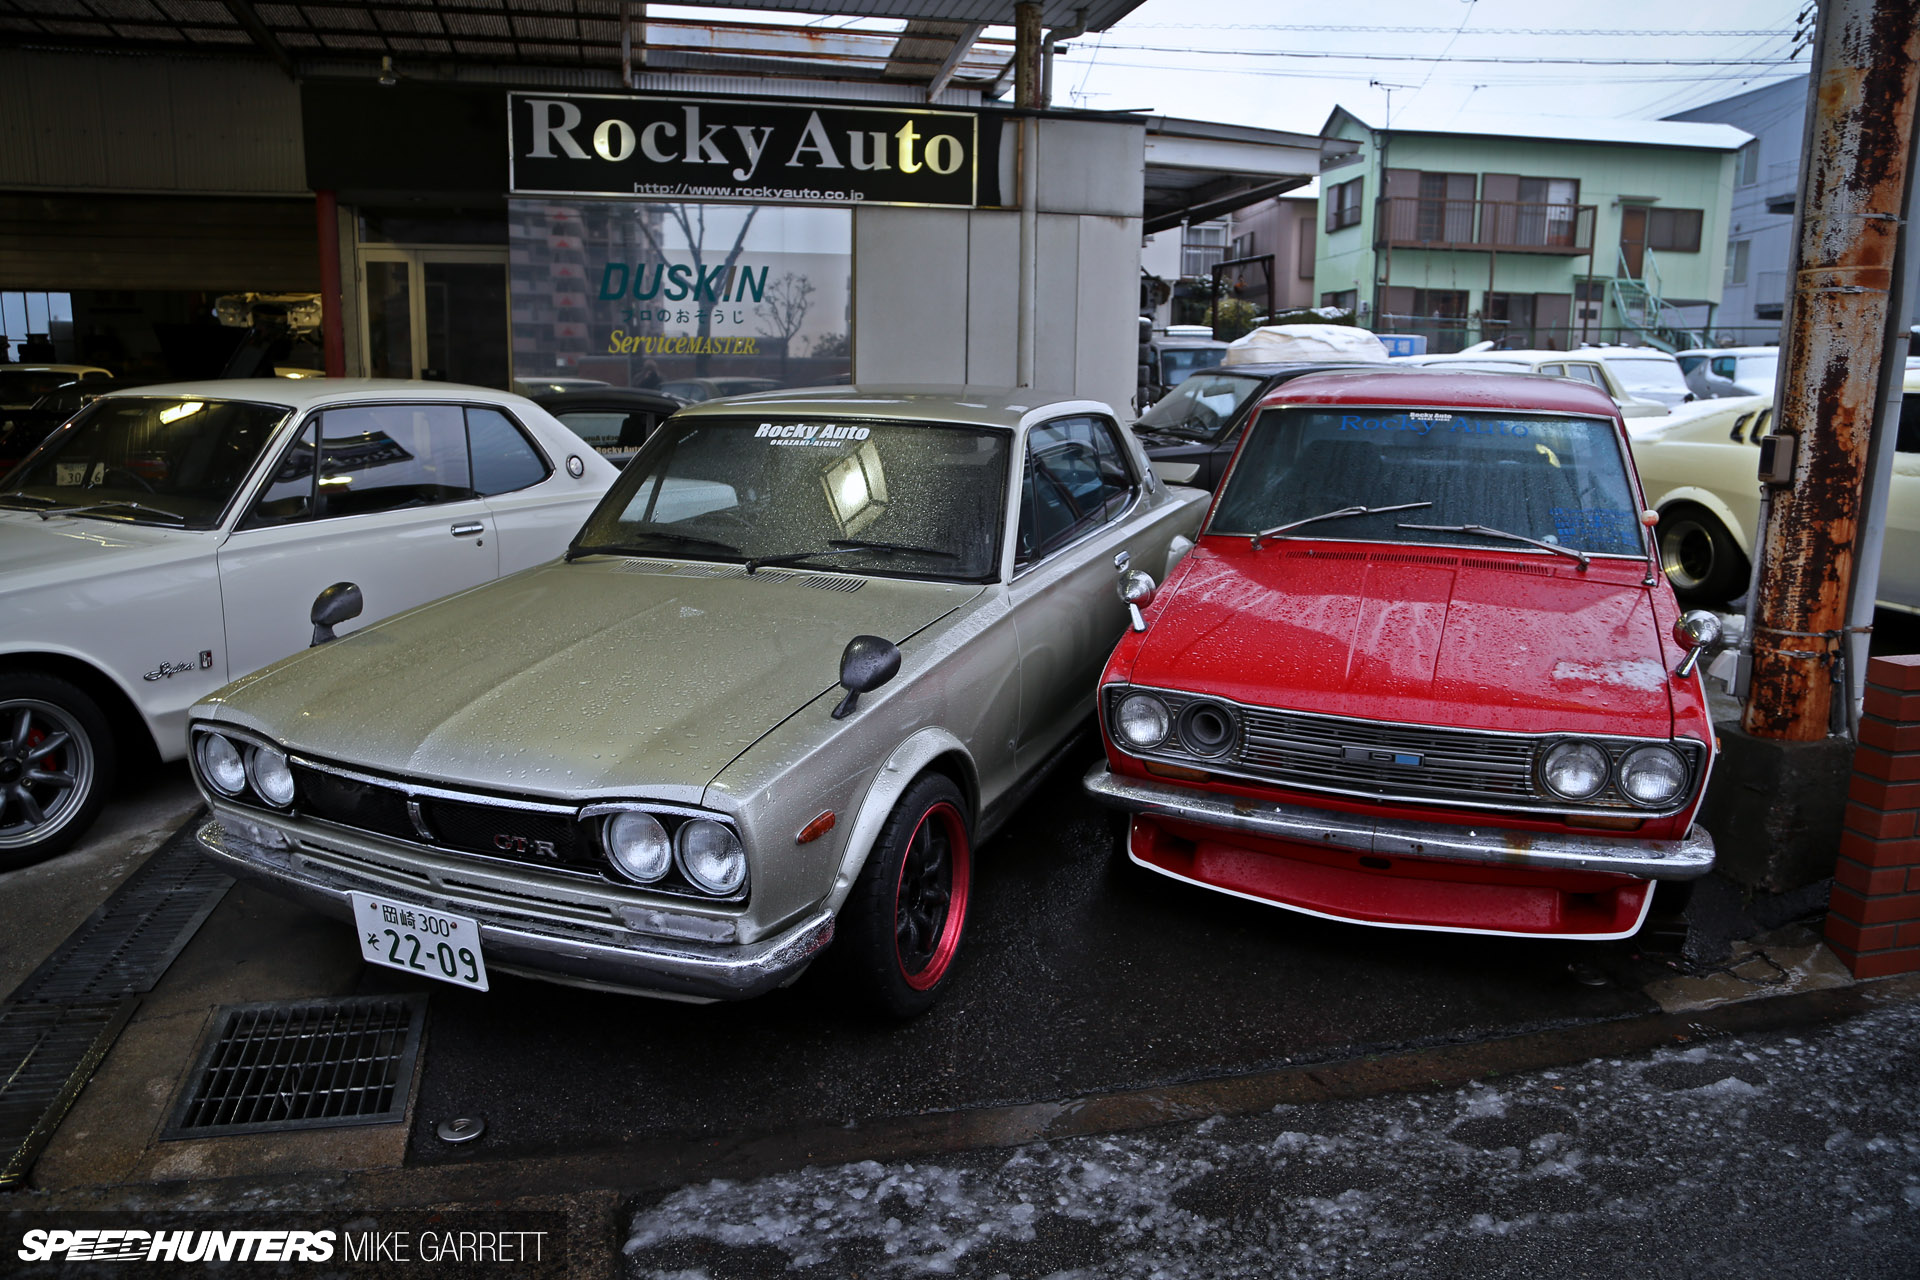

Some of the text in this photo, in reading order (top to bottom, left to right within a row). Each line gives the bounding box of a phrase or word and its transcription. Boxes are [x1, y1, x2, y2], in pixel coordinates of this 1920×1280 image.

[524, 99, 965, 181] Rocky Auto
[633, 182, 864, 201] http://www.rockyauto.co.jp
[599, 262, 769, 303] DUSKIN
[1337, 414, 1529, 438] Rocky Auto
[1434, 412, 1452, 420] Auto
[754, 423, 871, 441] Rocky Auto
[367, 928, 480, 983] そ 22-09
